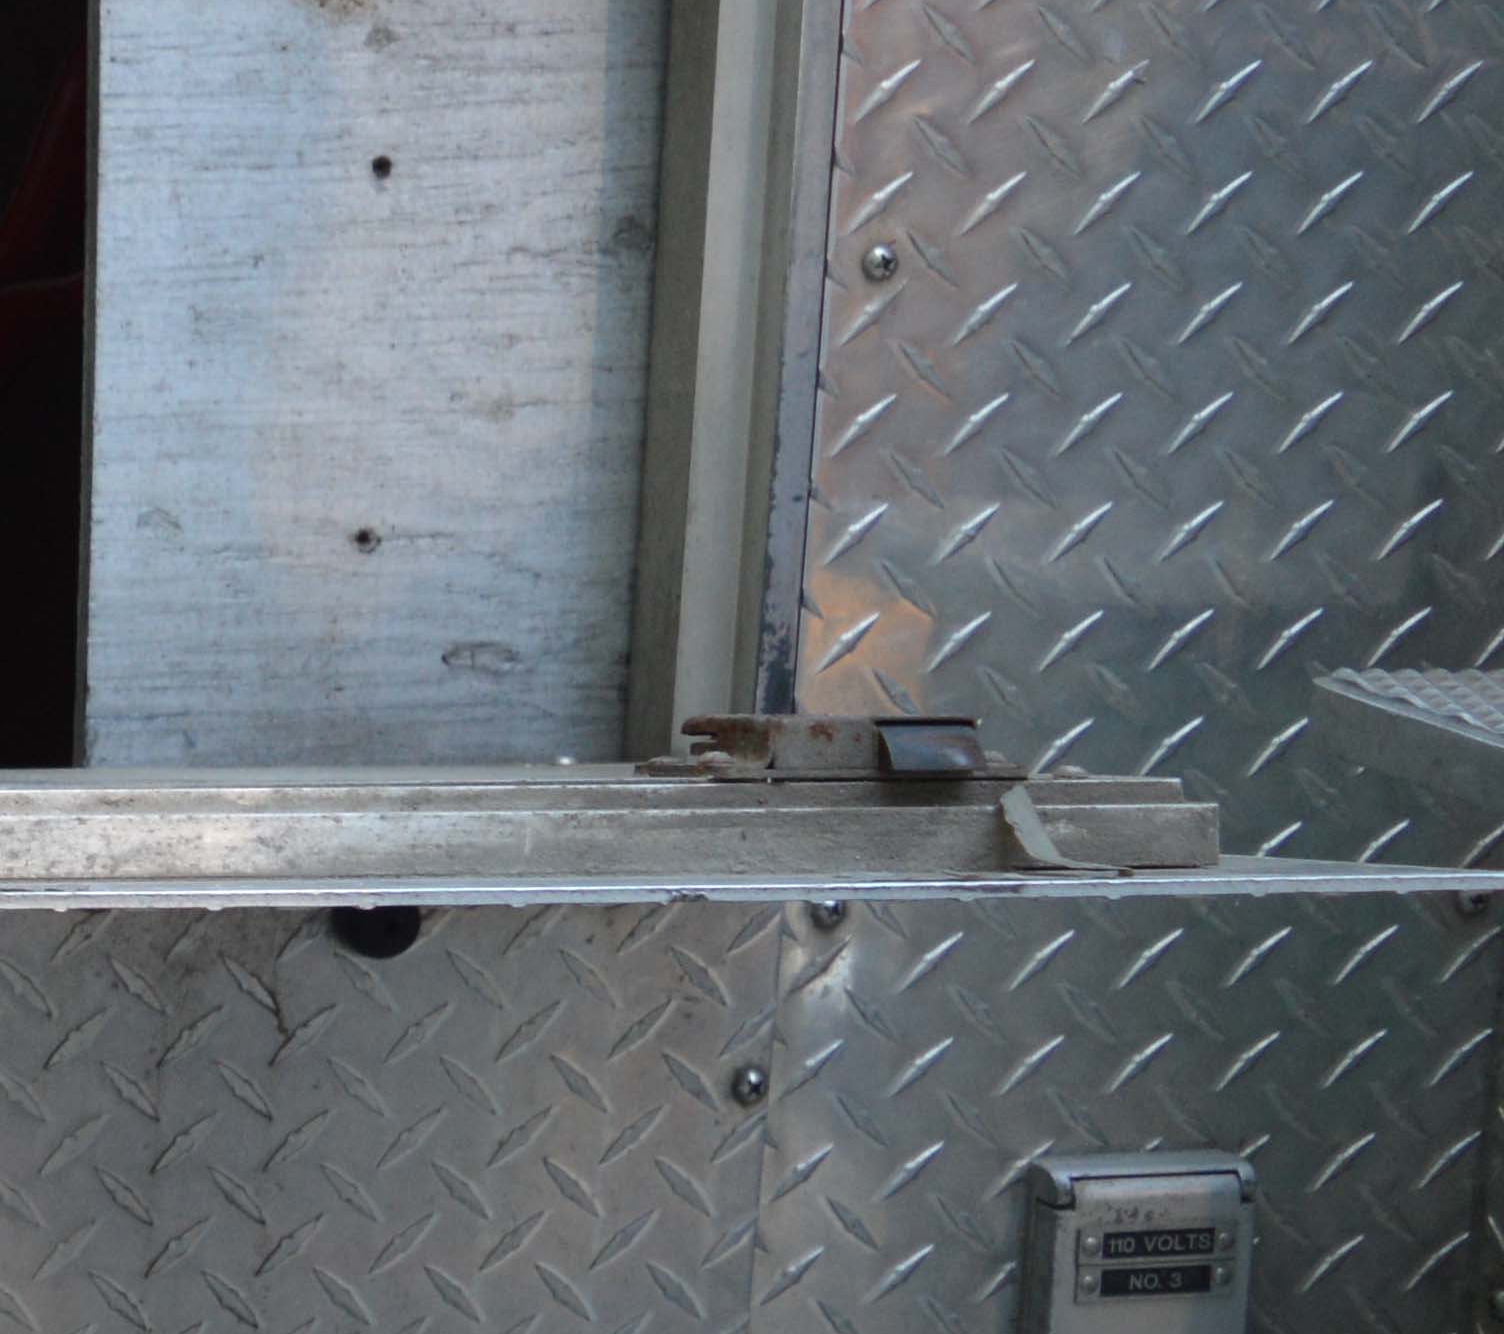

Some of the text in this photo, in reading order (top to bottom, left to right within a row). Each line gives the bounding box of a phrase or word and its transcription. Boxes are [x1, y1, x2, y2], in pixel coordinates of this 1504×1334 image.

[1109, 1233, 1211, 1254] 110 VOLTS
[1128, 1273, 1184, 1291] NO. 3
